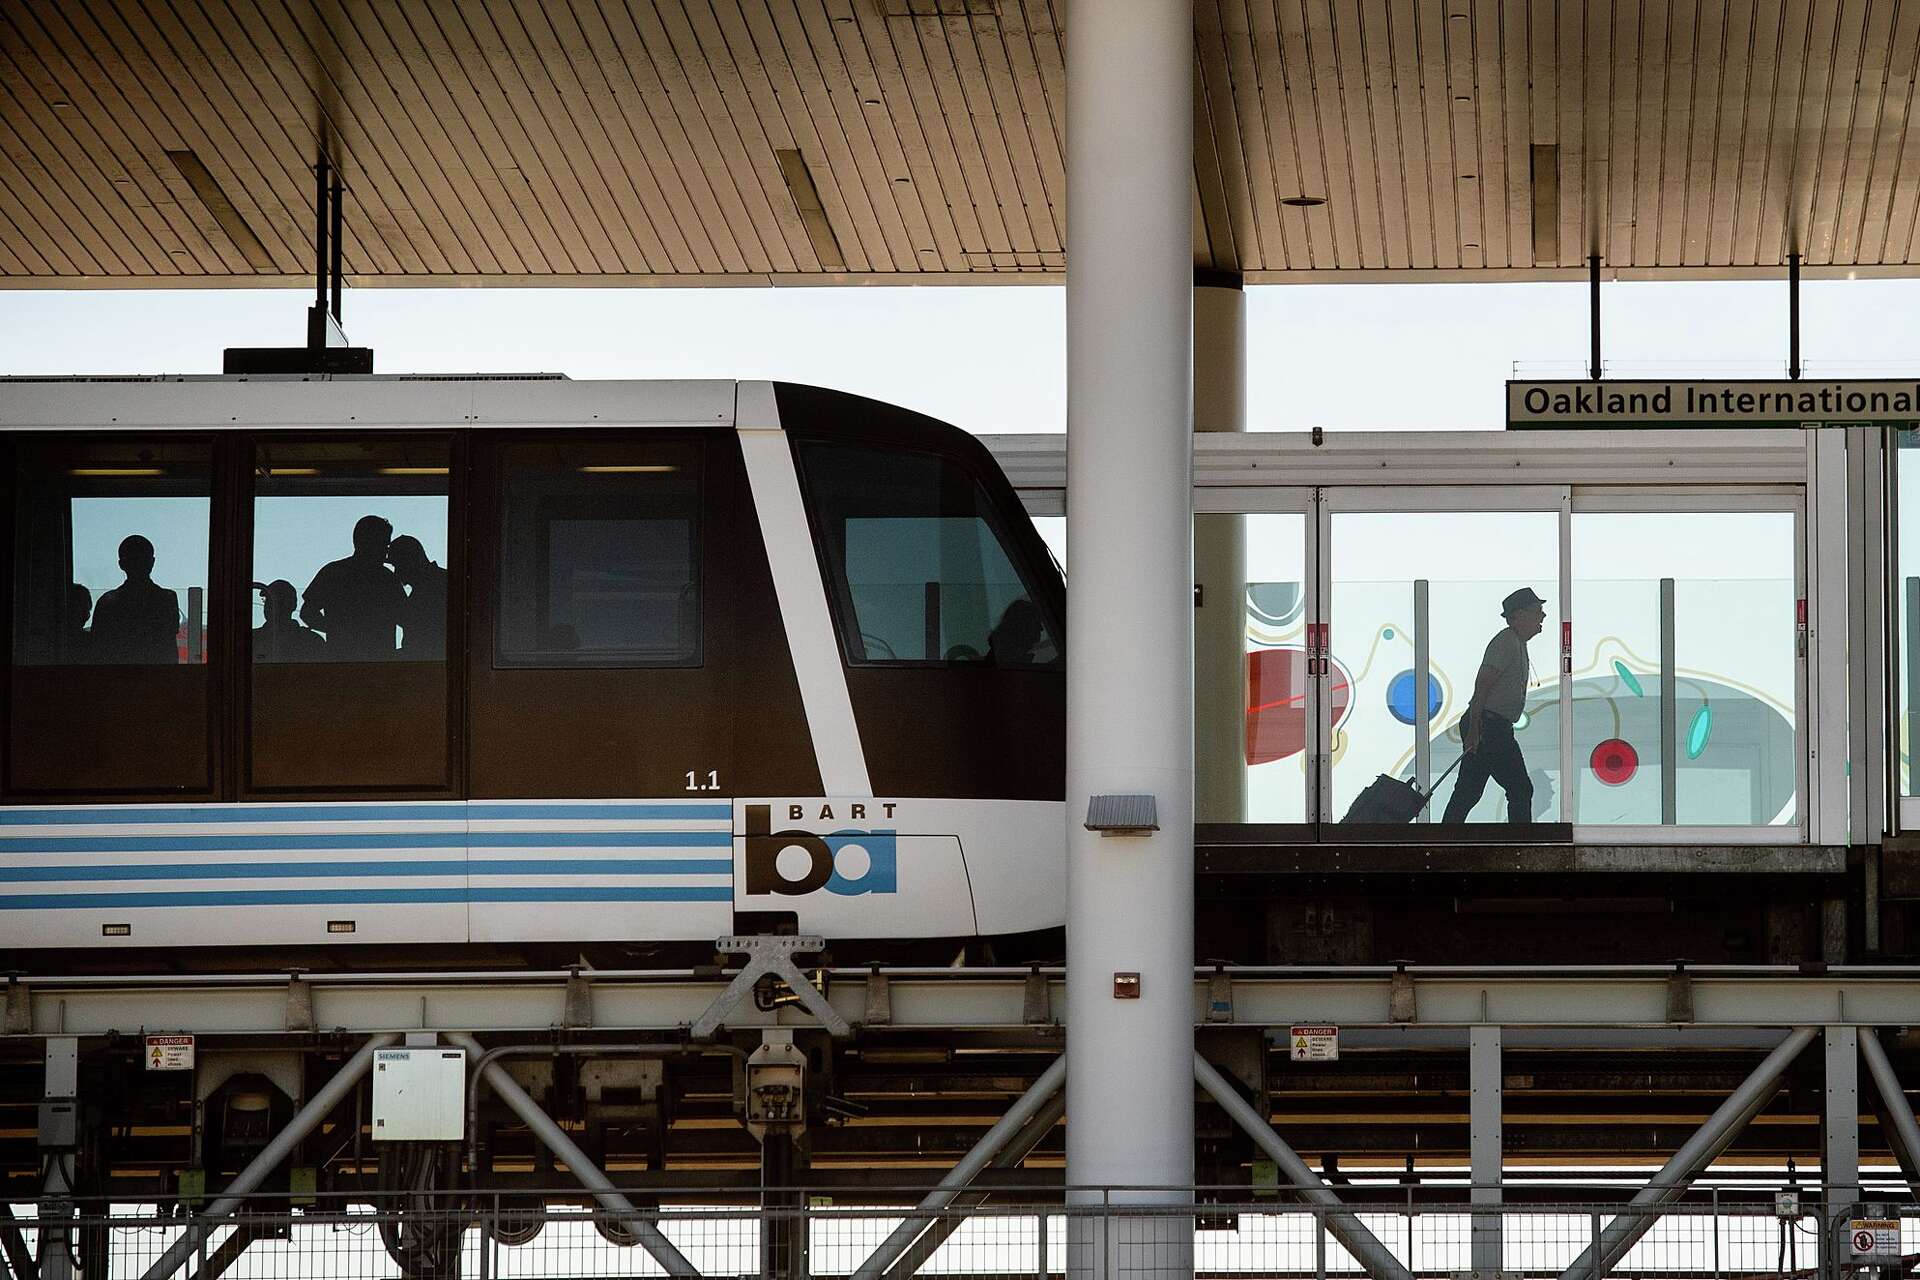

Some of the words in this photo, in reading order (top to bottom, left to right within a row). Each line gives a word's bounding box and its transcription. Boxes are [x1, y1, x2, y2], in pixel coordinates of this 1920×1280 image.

[1524, 386, 1672, 414] Oakland
[1687, 384, 1920, 414] International
[685, 770, 720, 790] 1.1
[789, 803, 897, 820] BART
